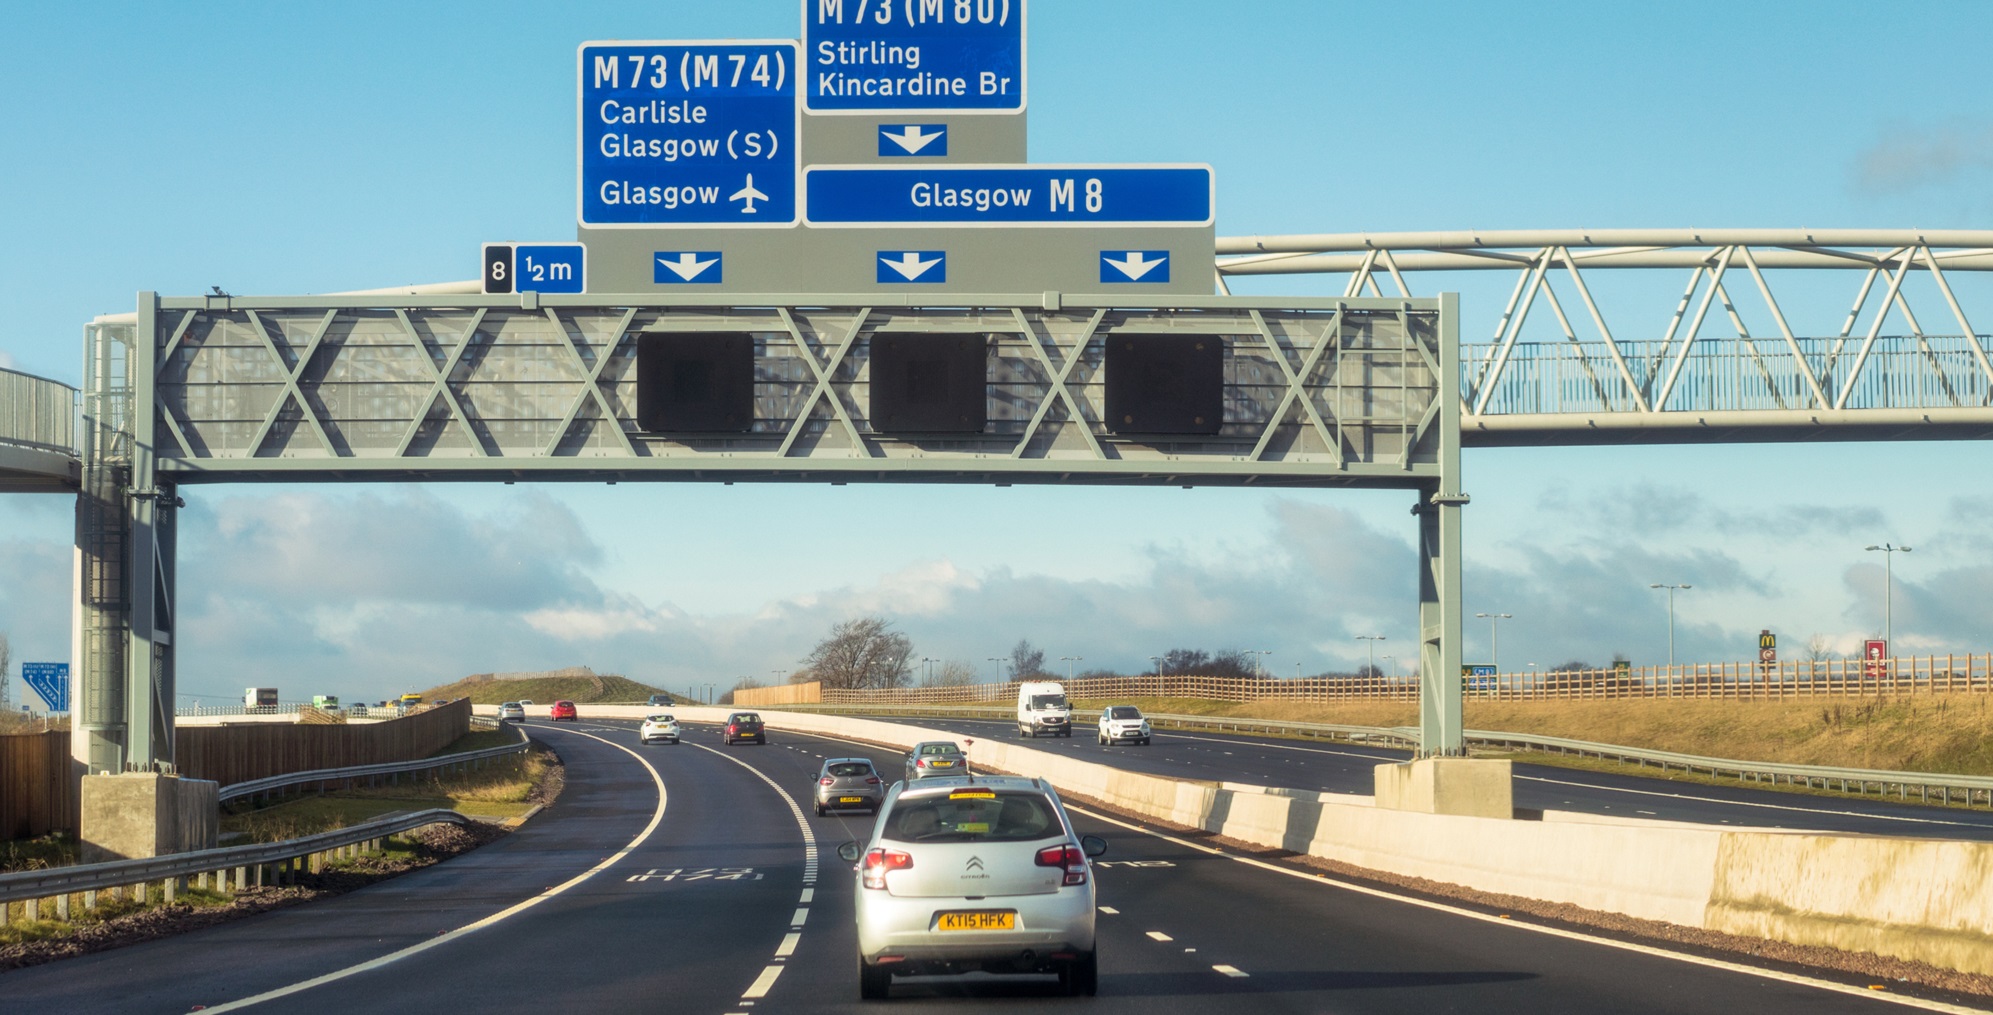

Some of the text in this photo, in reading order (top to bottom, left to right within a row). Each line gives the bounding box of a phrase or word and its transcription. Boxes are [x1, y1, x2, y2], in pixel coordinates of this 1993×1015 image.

[818, 41, 920, 69] Stirling
[819, 71, 1010, 96] Kincardine Br
[600, 100, 707, 124] Carlisle
[600, 133, 720, 162] Glasgow
[600, 180, 720, 209] Glasgow
[911, 182, 1032, 212] Glasgow
[492, 261, 505, 280] 8
[947, 912, 1006, 927] KT15 HFK
